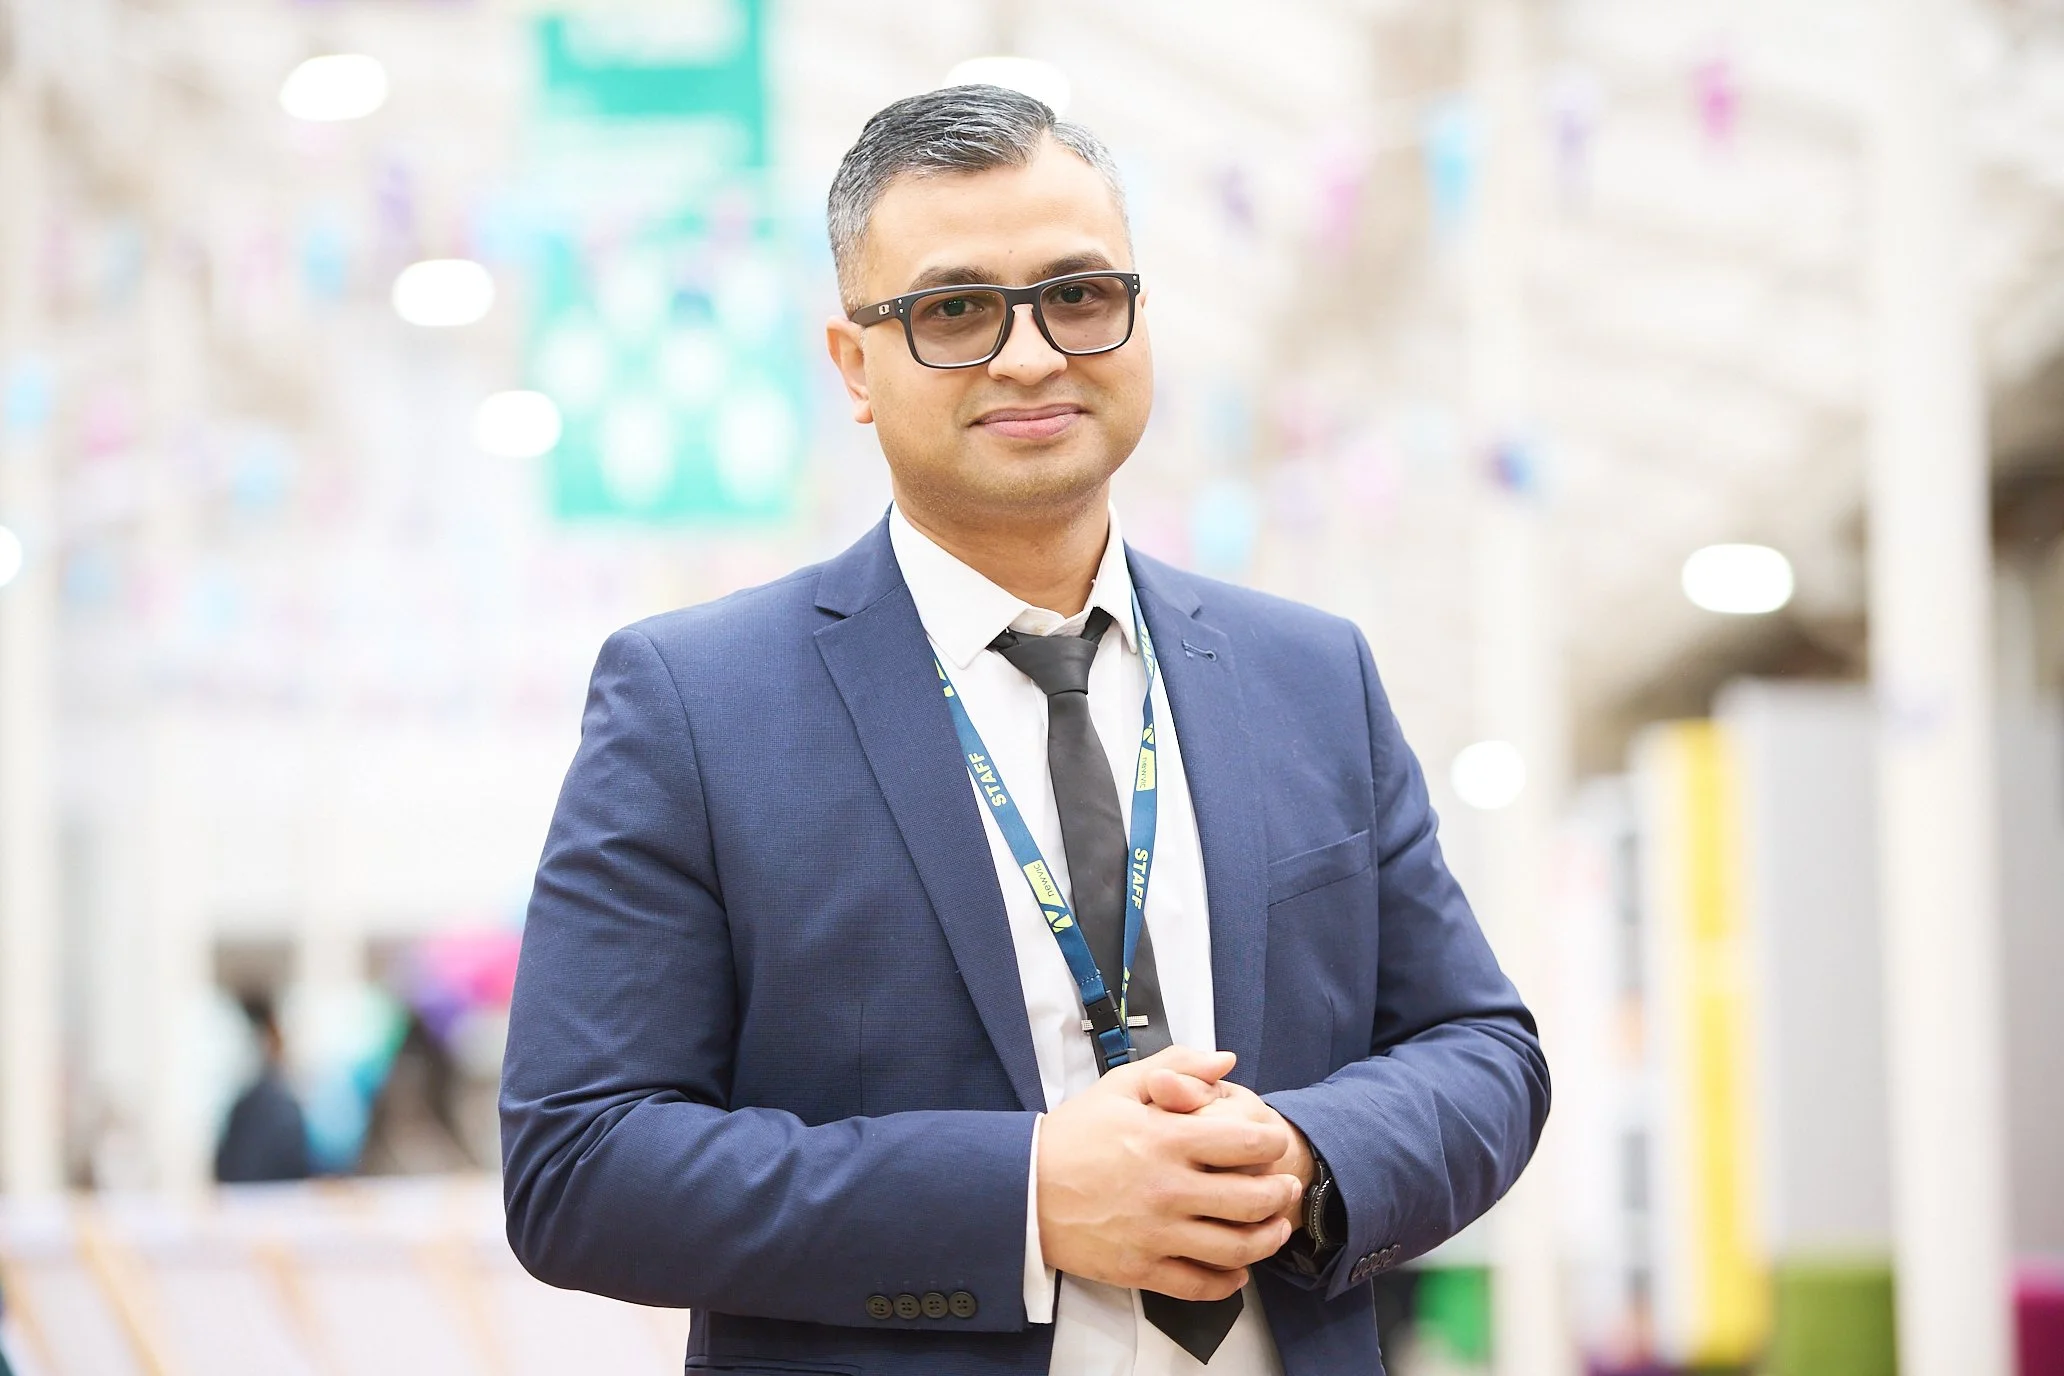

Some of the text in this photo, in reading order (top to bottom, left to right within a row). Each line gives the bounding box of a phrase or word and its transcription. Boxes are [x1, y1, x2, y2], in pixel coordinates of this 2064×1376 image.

[968, 752, 1007, 807] STAFF
[1033, 863, 1055, 897] newvic
[1131, 847, 1149, 910] STAFF
